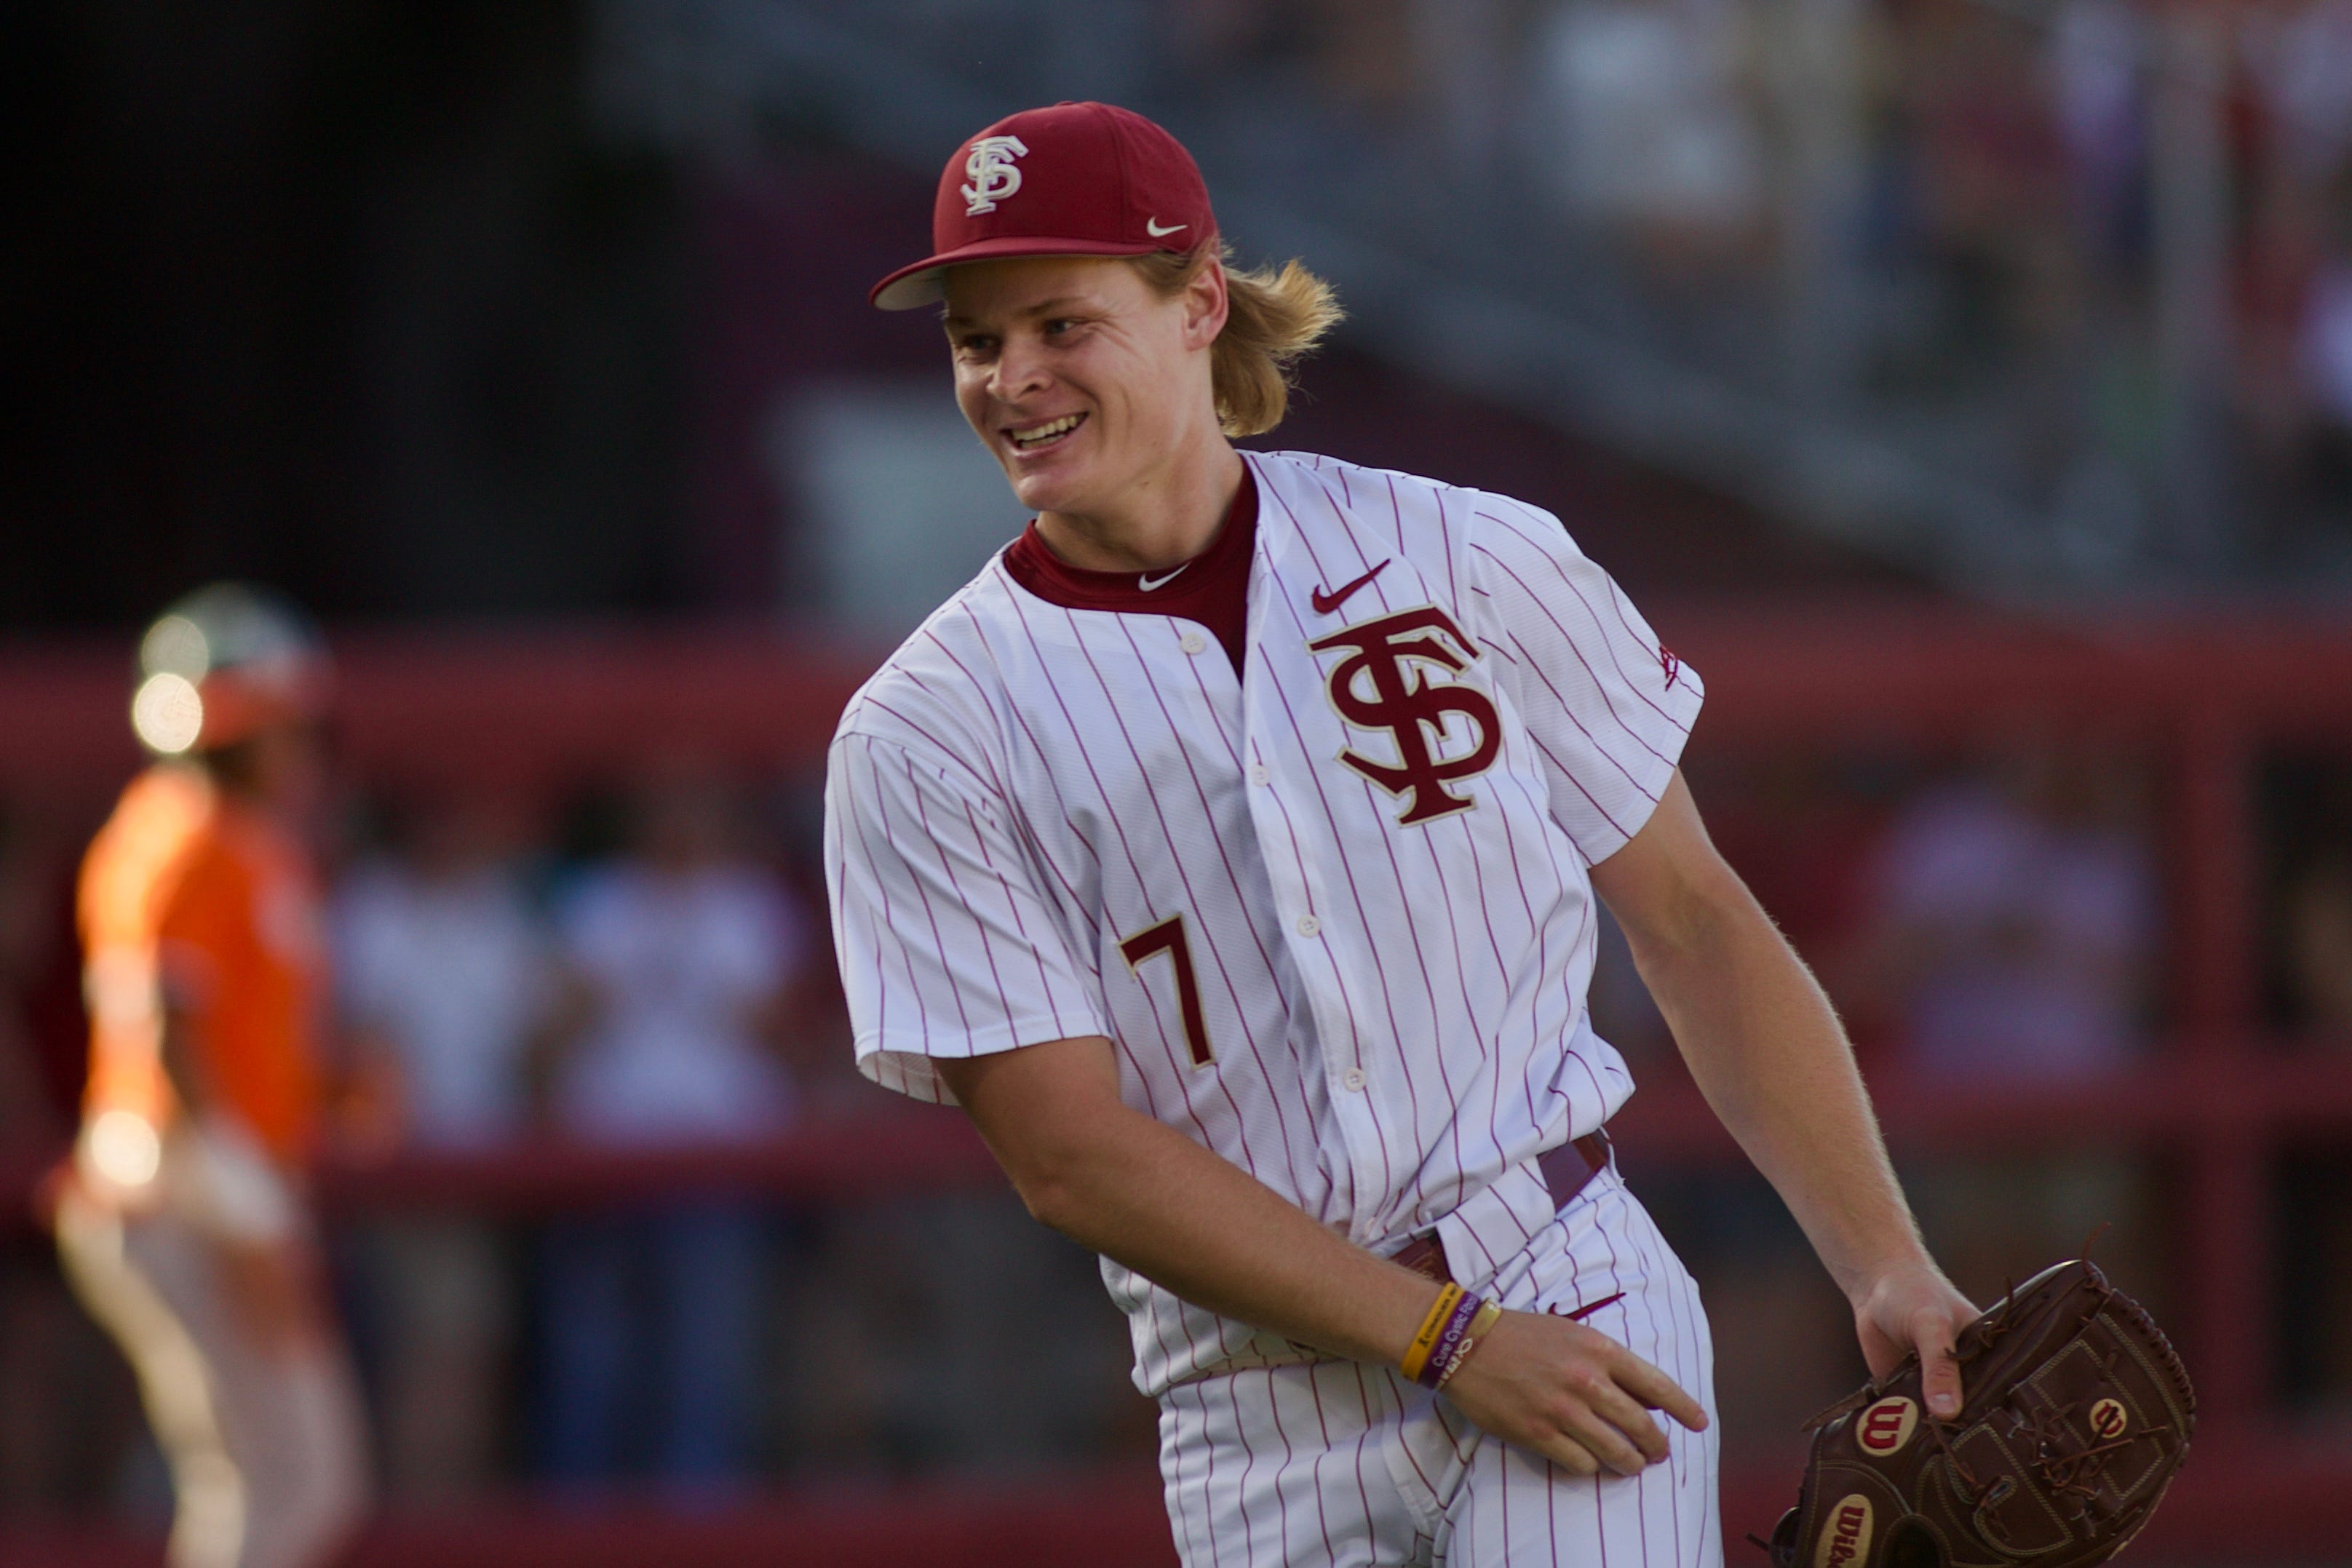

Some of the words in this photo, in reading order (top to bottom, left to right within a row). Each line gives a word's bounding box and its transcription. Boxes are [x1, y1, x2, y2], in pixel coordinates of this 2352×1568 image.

[1116, 912, 1216, 1073] 7
[1431, 1343, 1453, 1367] Cure
[1445, 1313, 1469, 1342] Cystic
[1862, 1401, 1907, 1451] W
